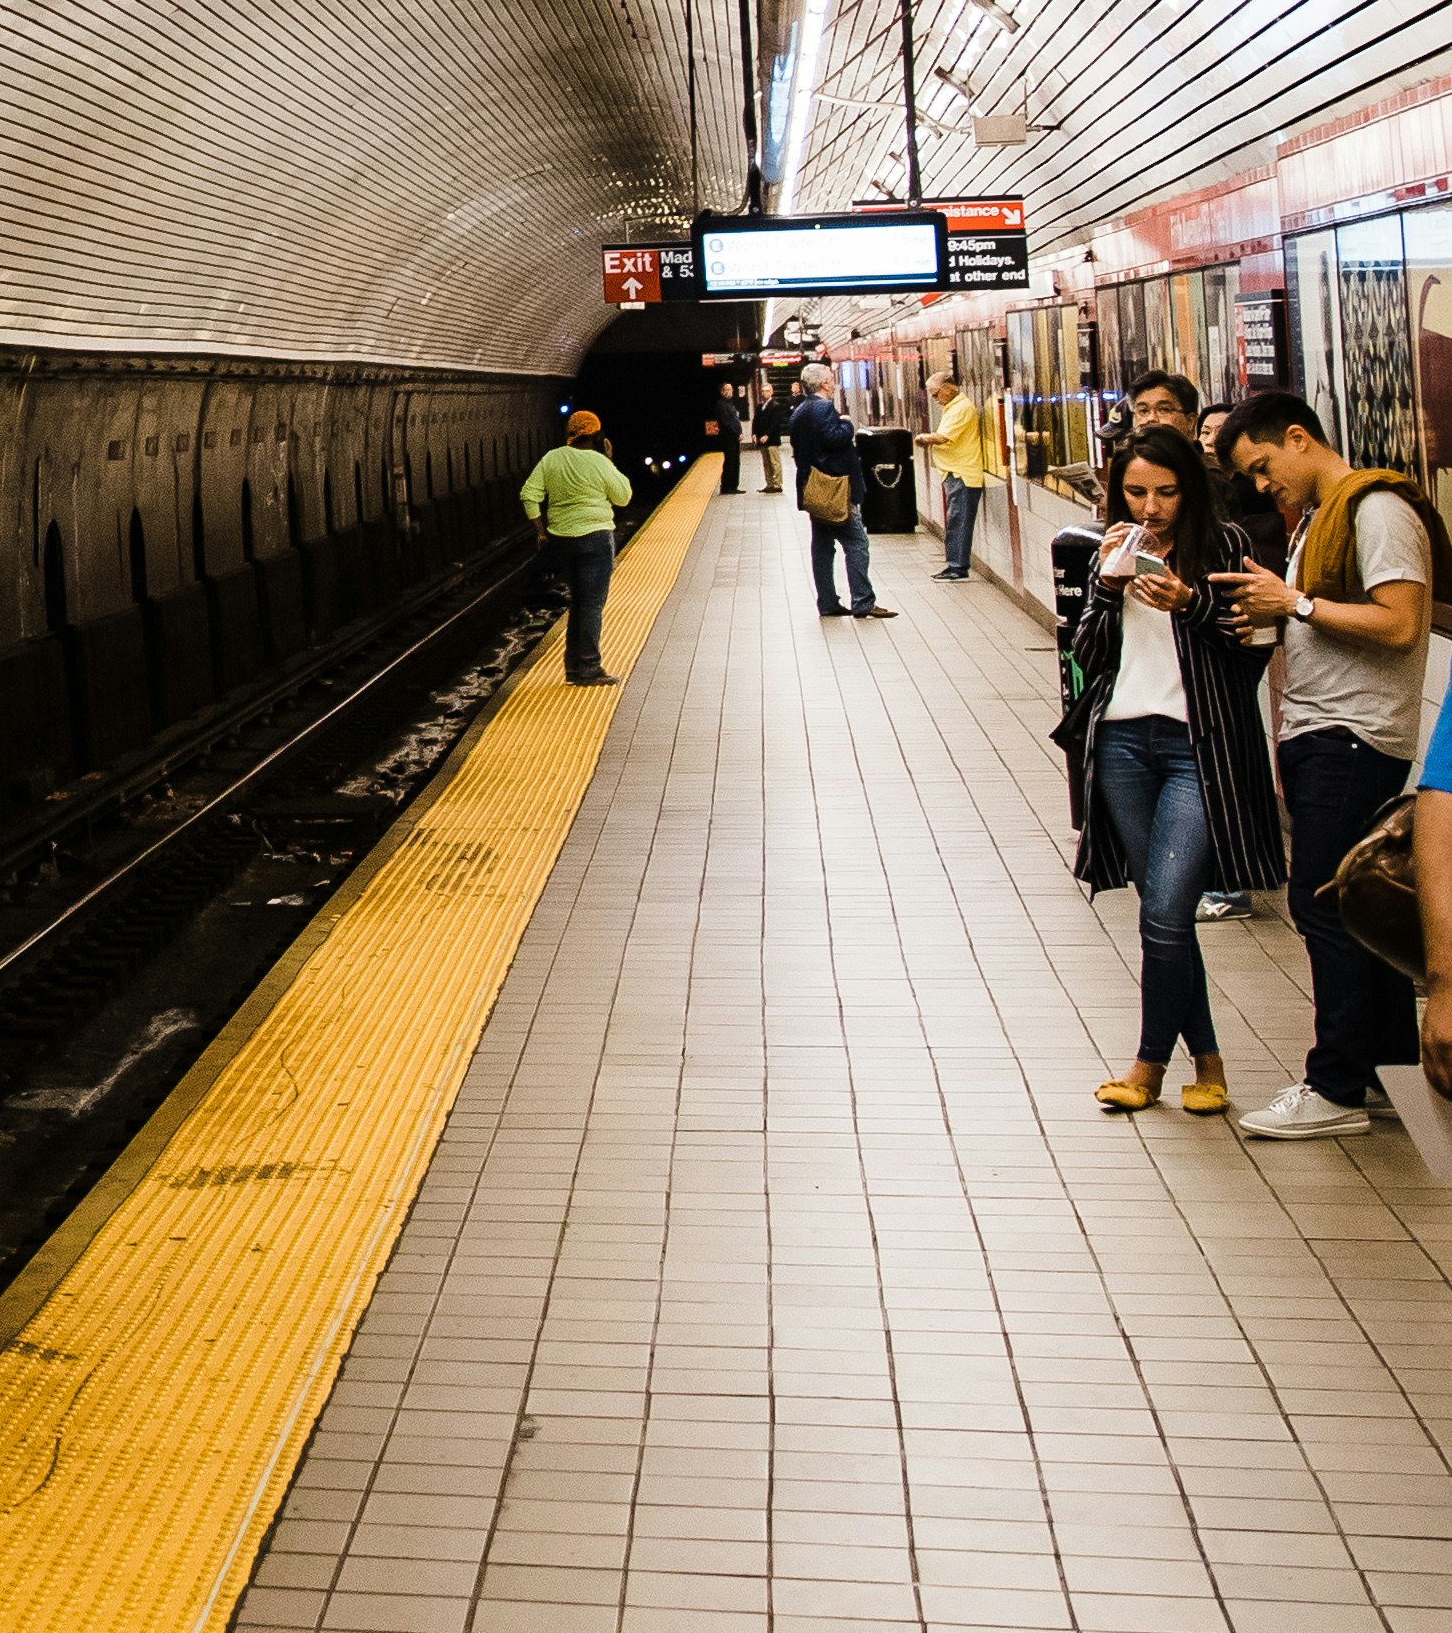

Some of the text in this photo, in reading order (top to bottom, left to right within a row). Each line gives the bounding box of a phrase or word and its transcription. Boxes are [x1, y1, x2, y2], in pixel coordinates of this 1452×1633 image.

[604, 252, 653, 274] Exit
[958, 254, 1016, 268] Holidays.
[661, 265, 673, 278] &
[964, 270, 998, 282] other
[1001, 269, 1026, 281] end
